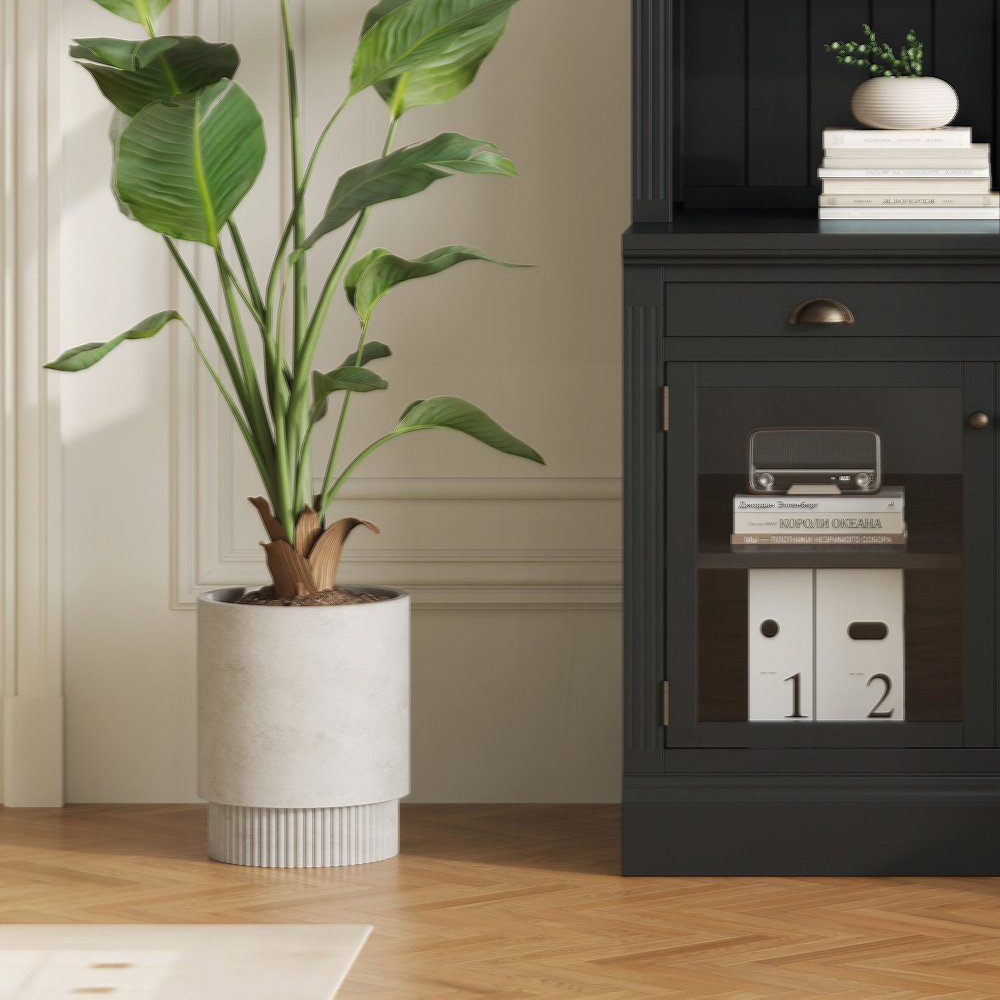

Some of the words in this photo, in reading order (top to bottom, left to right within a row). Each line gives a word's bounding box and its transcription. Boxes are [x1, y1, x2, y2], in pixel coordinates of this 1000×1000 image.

[779, 518, 829, 529] КОРОЛИ
[831, 518, 882, 529] ОКЕАНА
[783, 671, 808, 718] 1
[866, 672, 895, 718] 2
